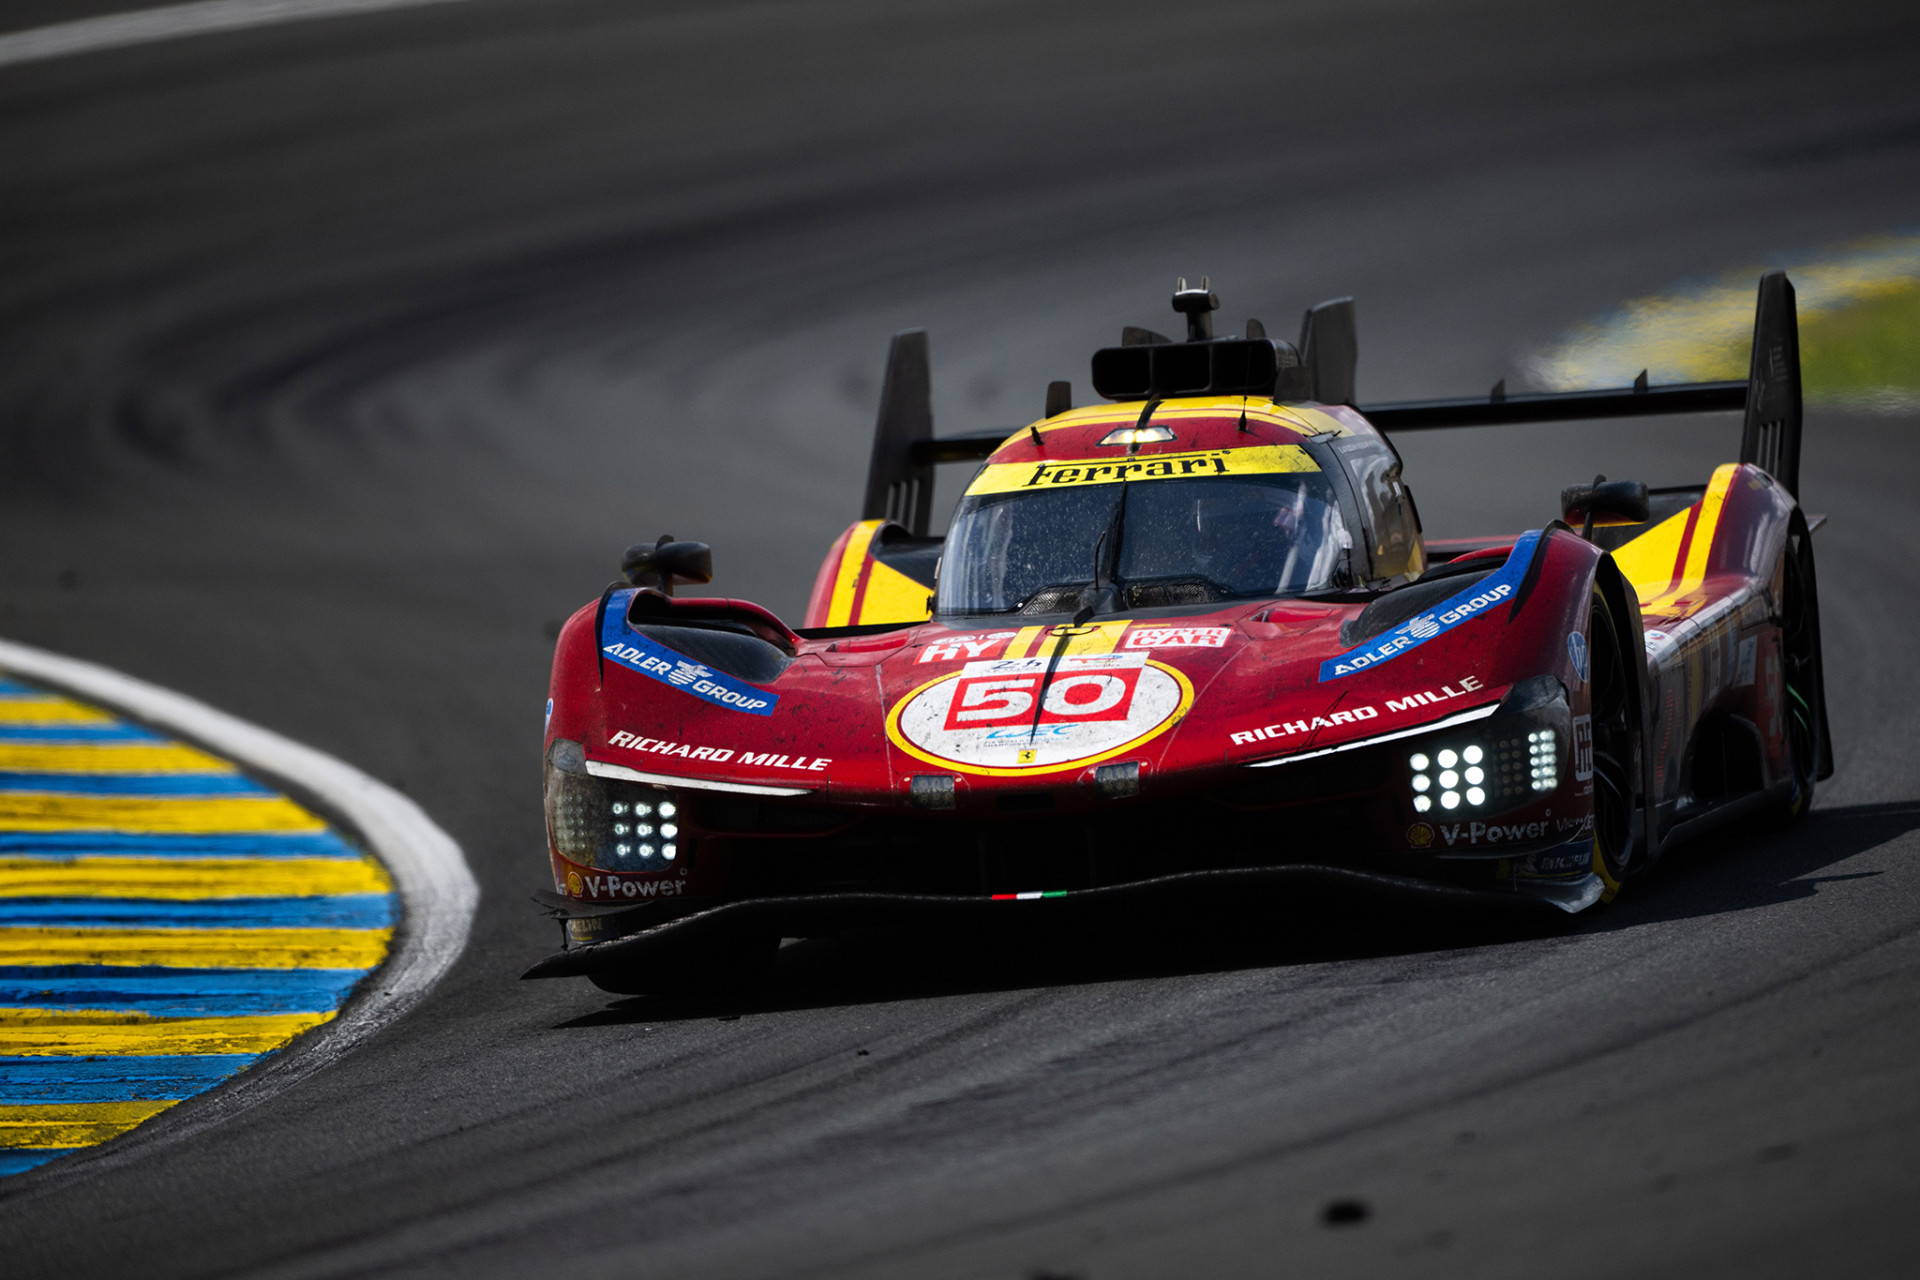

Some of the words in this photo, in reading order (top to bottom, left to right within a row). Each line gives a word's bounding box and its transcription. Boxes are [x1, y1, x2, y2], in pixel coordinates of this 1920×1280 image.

[1022, 452, 1230, 487] Ferrari
[1132, 635, 1219, 647] CAR
[1136, 629, 1223, 637] HYPER
[1334, 636, 1414, 676] ADLER
[1438, 583, 1512, 624] GROUP
[918, 640, 1000, 663] HY
[603, 642, 672, 676] ADLER
[692, 679, 768, 711] GROUP
[955, 674, 1128, 722] 50
[1230, 706, 1379, 746] RICHARD
[1384, 675, 1484, 713] MILLE
[608, 730, 736, 762] RICHARD
[737, 752, 832, 772] MILLE
[1439, 820, 1549, 846] V-Power
[584, 875, 687, 899] V-Power
